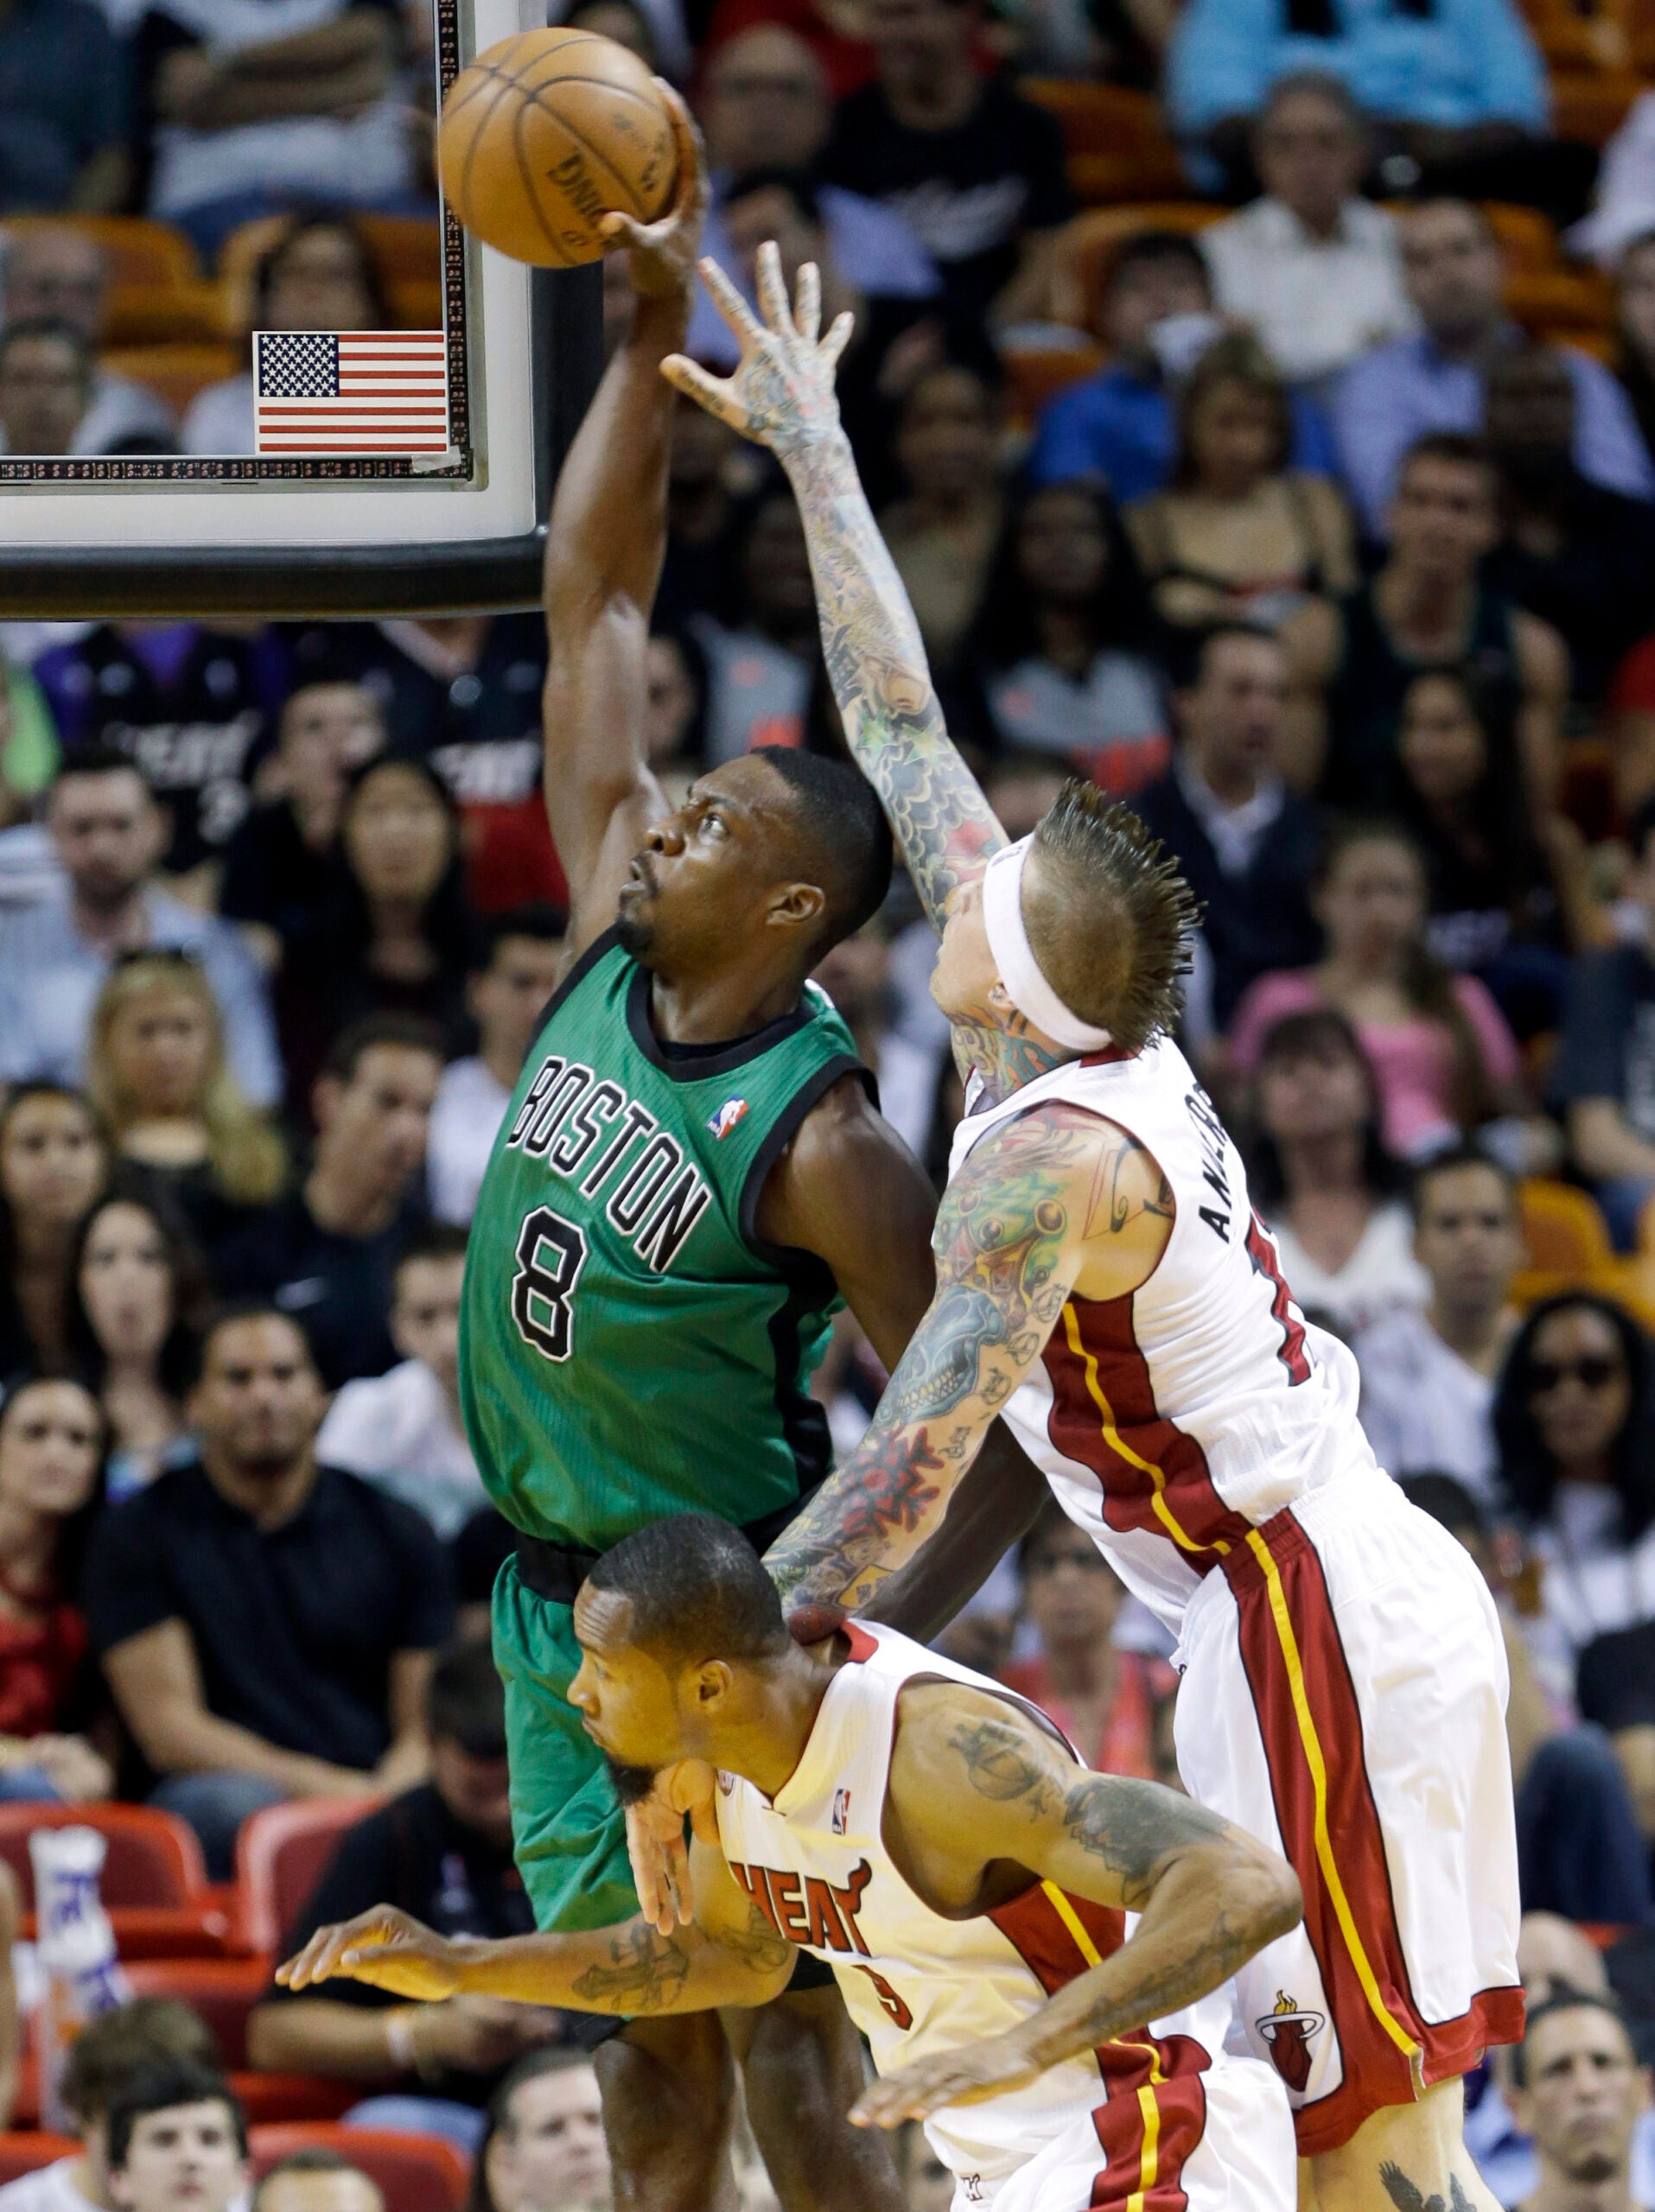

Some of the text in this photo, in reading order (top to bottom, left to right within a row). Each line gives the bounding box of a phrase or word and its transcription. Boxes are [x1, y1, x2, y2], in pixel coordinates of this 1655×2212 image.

[506, 1055, 713, 1274] BOSTON
[512, 1205, 589, 1363] 8
[729, 1858, 872, 1958] HEAT
